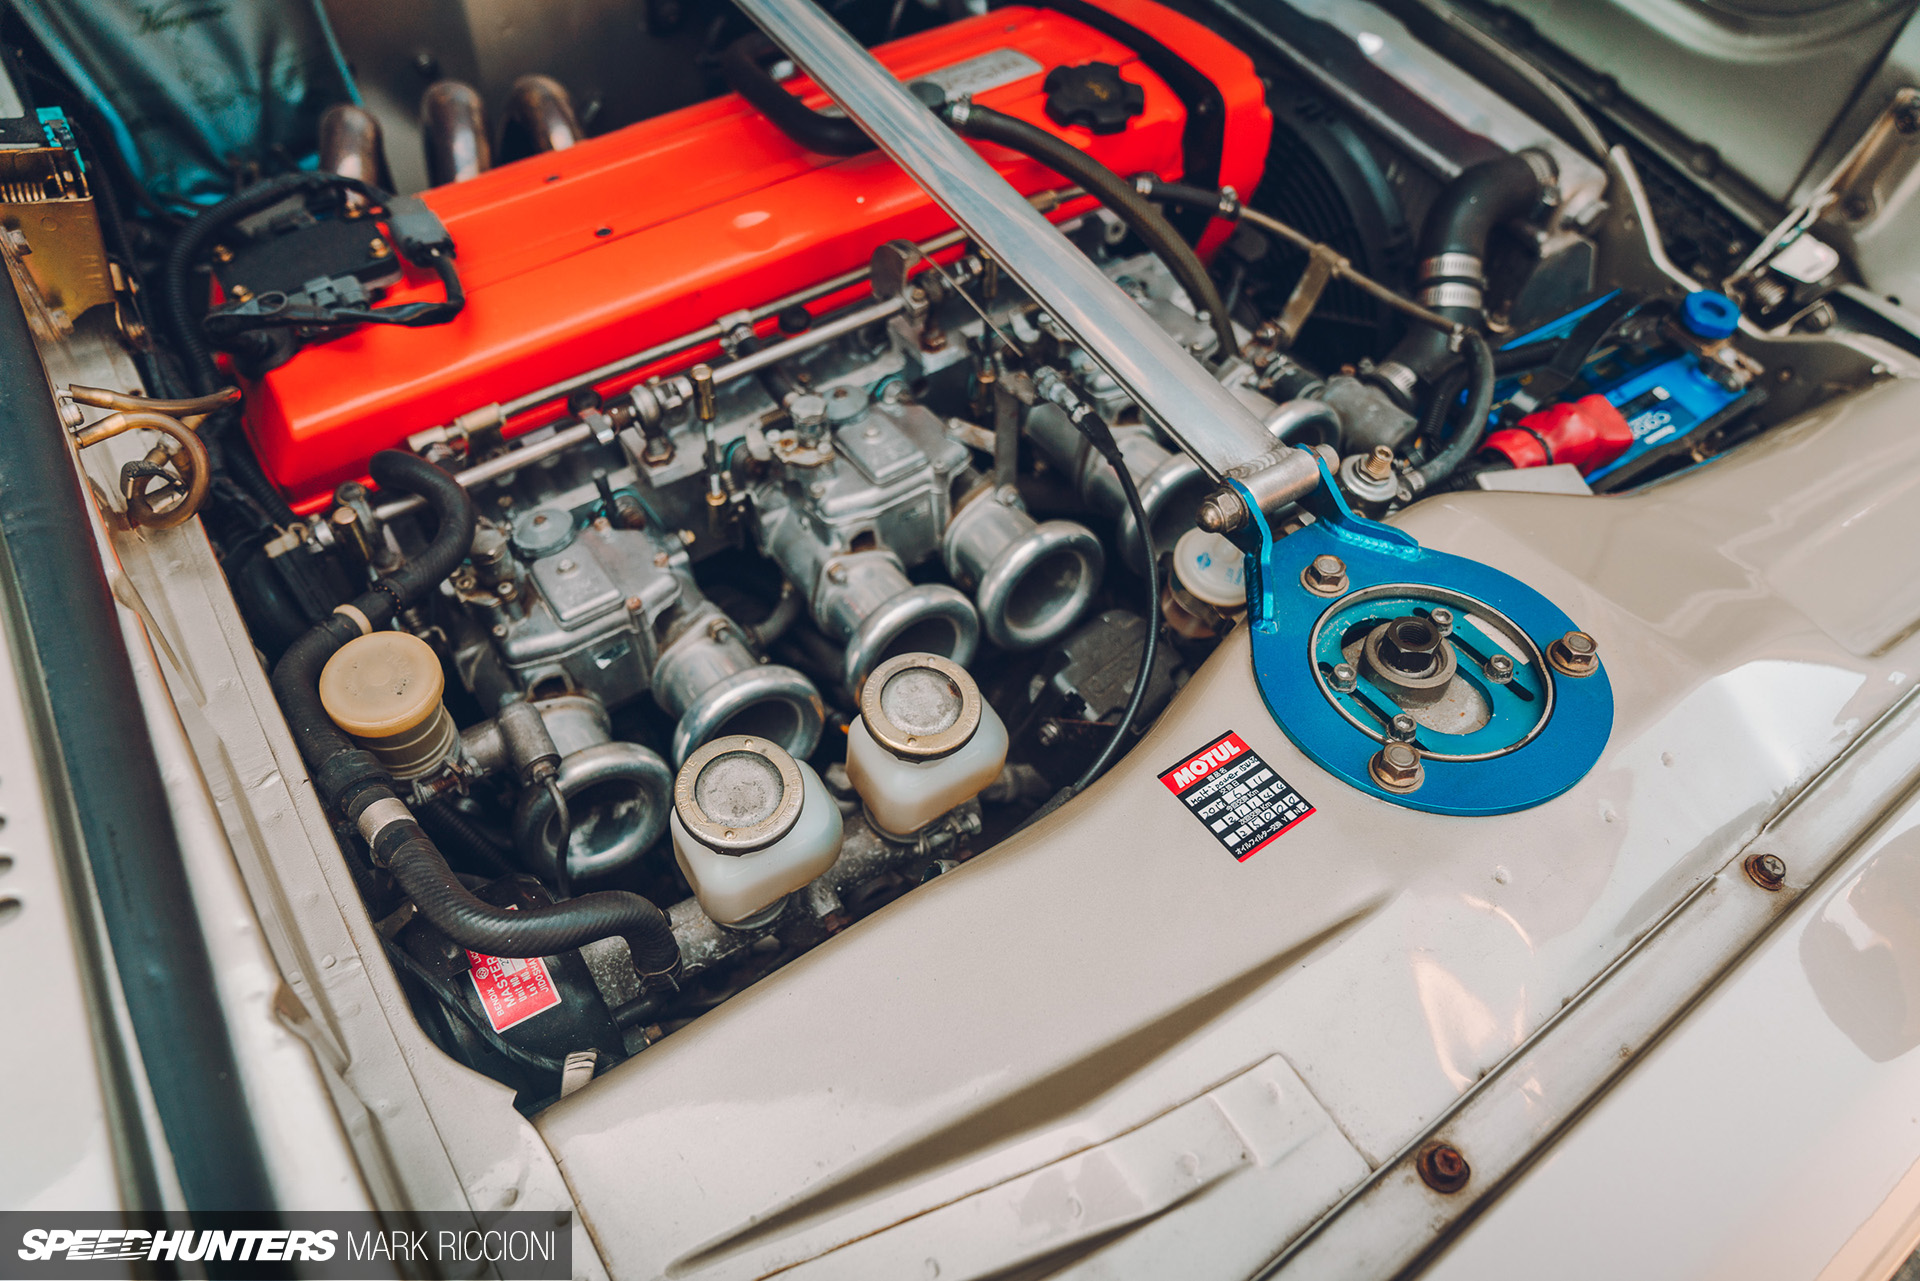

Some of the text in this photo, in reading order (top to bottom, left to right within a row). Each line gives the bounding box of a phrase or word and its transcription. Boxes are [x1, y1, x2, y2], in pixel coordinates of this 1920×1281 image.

[677, 759, 697, 811] REMOVE
[1172, 741, 1241, 788] MOTUL
[487, 987, 504, 1016] BENDIX
